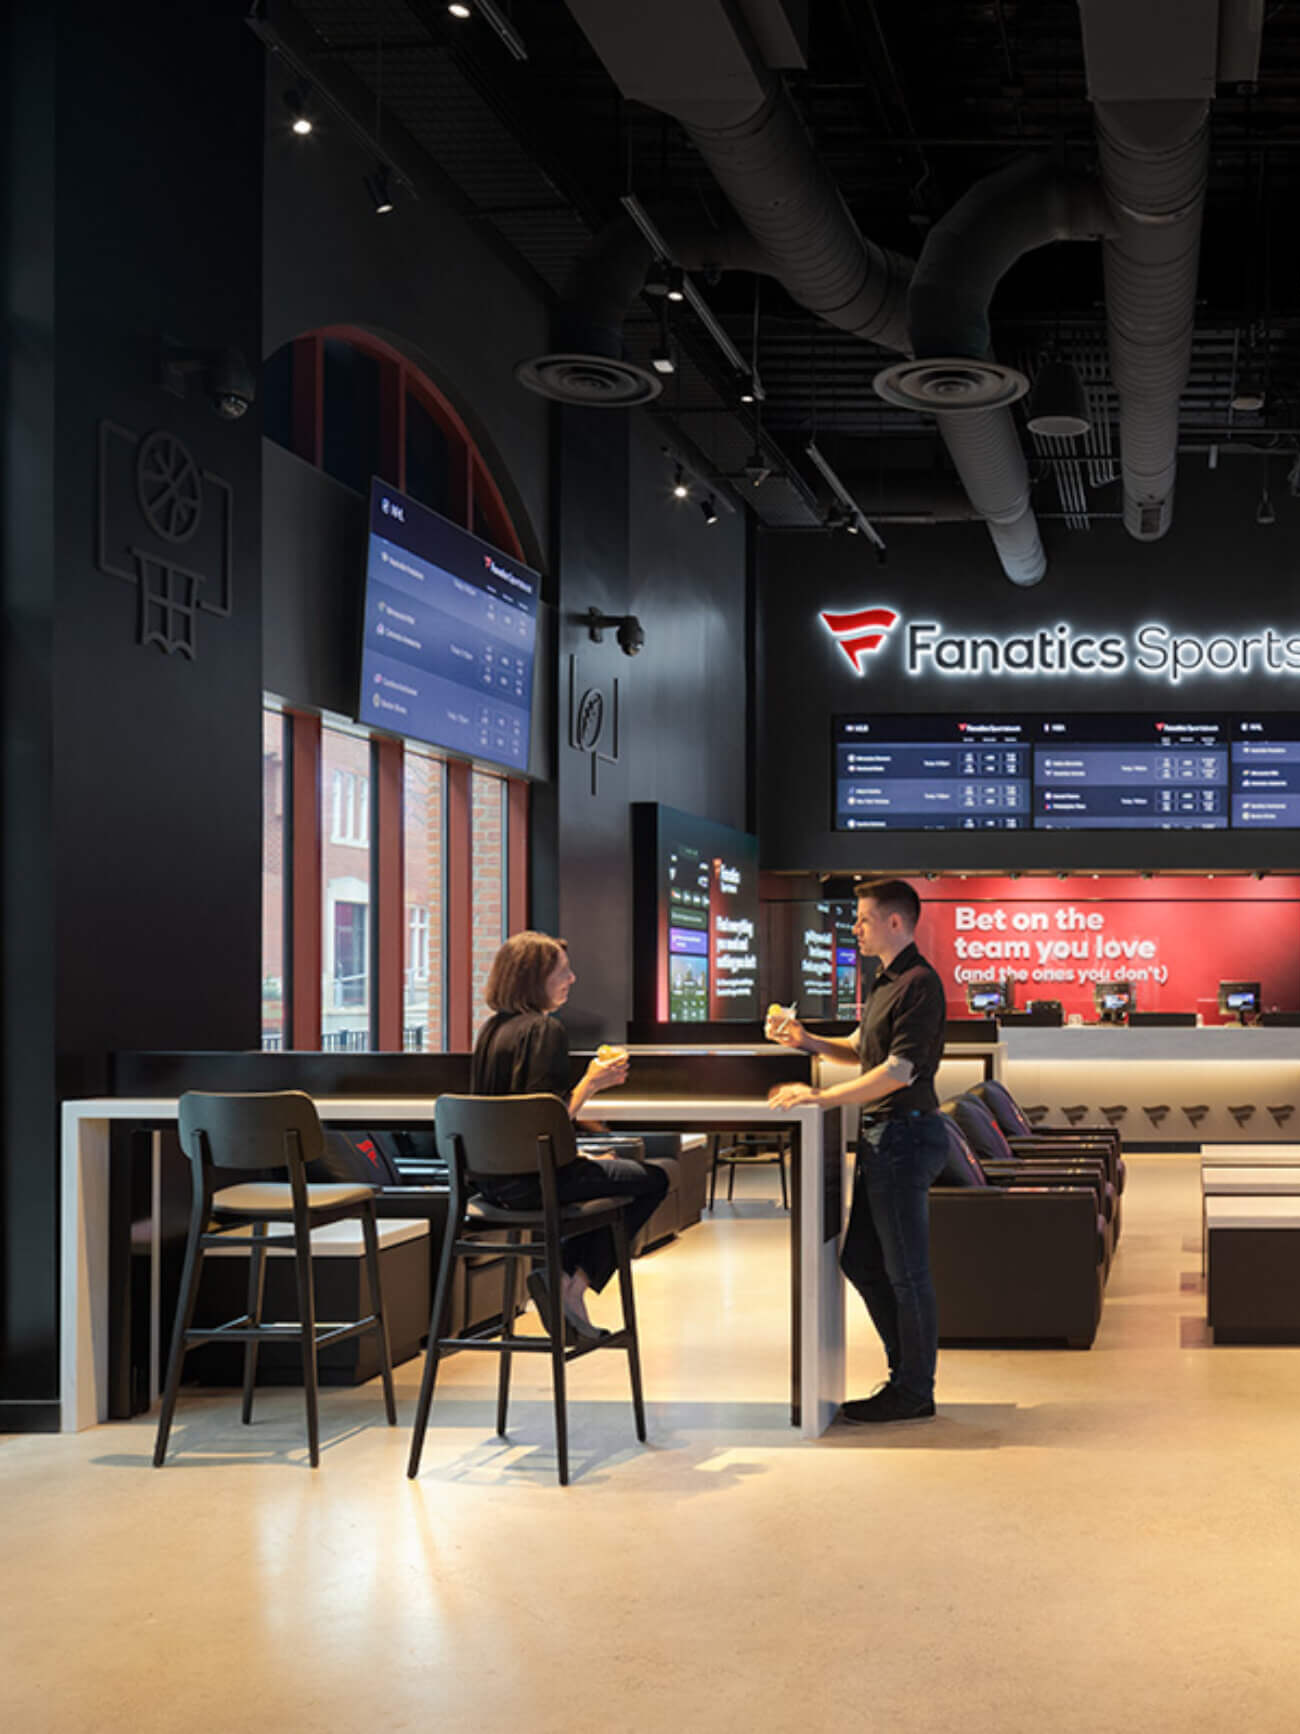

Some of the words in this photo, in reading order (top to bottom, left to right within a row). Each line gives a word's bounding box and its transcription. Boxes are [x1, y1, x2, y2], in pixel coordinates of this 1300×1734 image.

[907, 623, 1126, 671] Fanatics
[955, 907, 1007, 930] Bet
[1012, 912, 1048, 930] on
[1055, 907, 1104, 930] the
[954, 937, 1030, 958] team
[1036, 941, 1089, 965] you
[1096, 935, 1156, 958] love
[954, 965, 995, 983] (and
[999, 966, 1028, 981] the
[1032, 969, 1075, 981] ones
[1078, 969, 1111, 984] you
[1114, 965, 1168, 984] don't)
